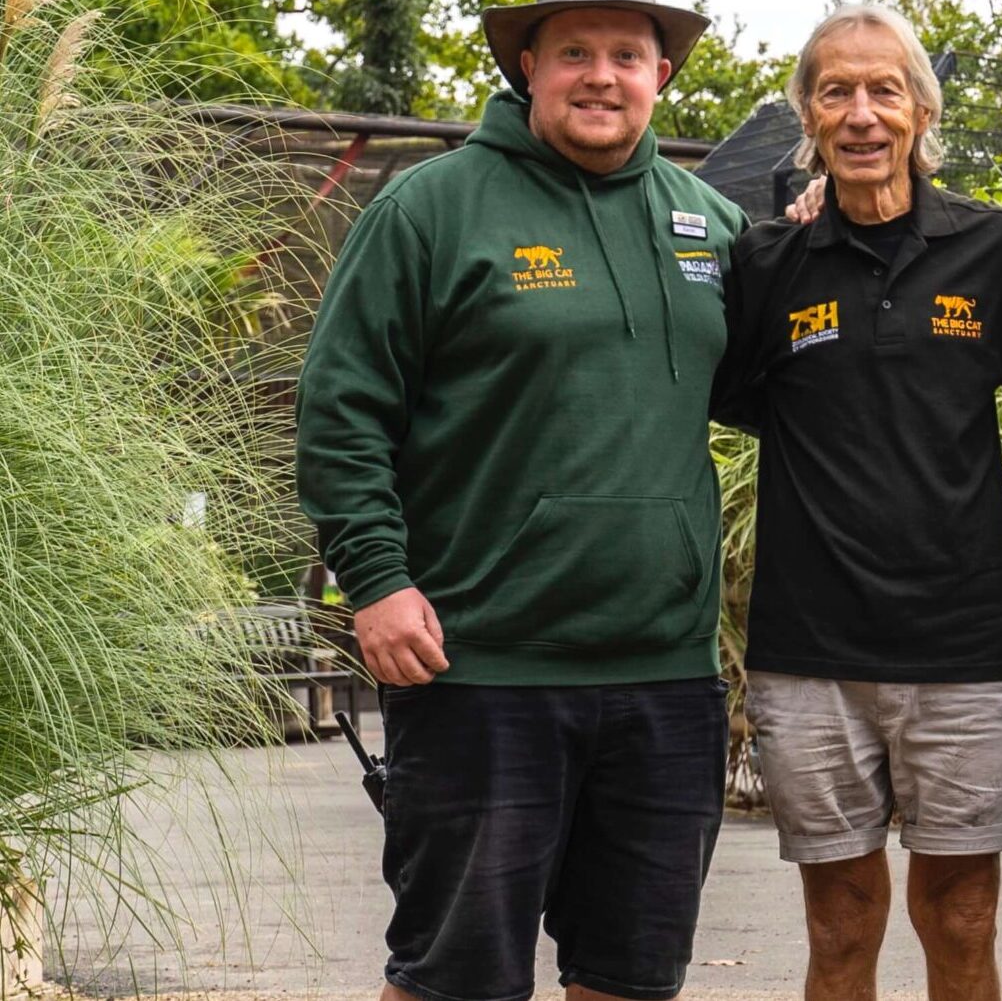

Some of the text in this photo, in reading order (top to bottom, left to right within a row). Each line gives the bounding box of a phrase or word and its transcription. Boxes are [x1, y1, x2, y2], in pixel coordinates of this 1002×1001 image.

[512, 268, 573, 281] THE BIG CAT
[516, 280, 576, 291] SANCTUARY
[931, 317, 982, 331] THE BIG CAT
[933, 327, 981, 338] SANCTUARY
